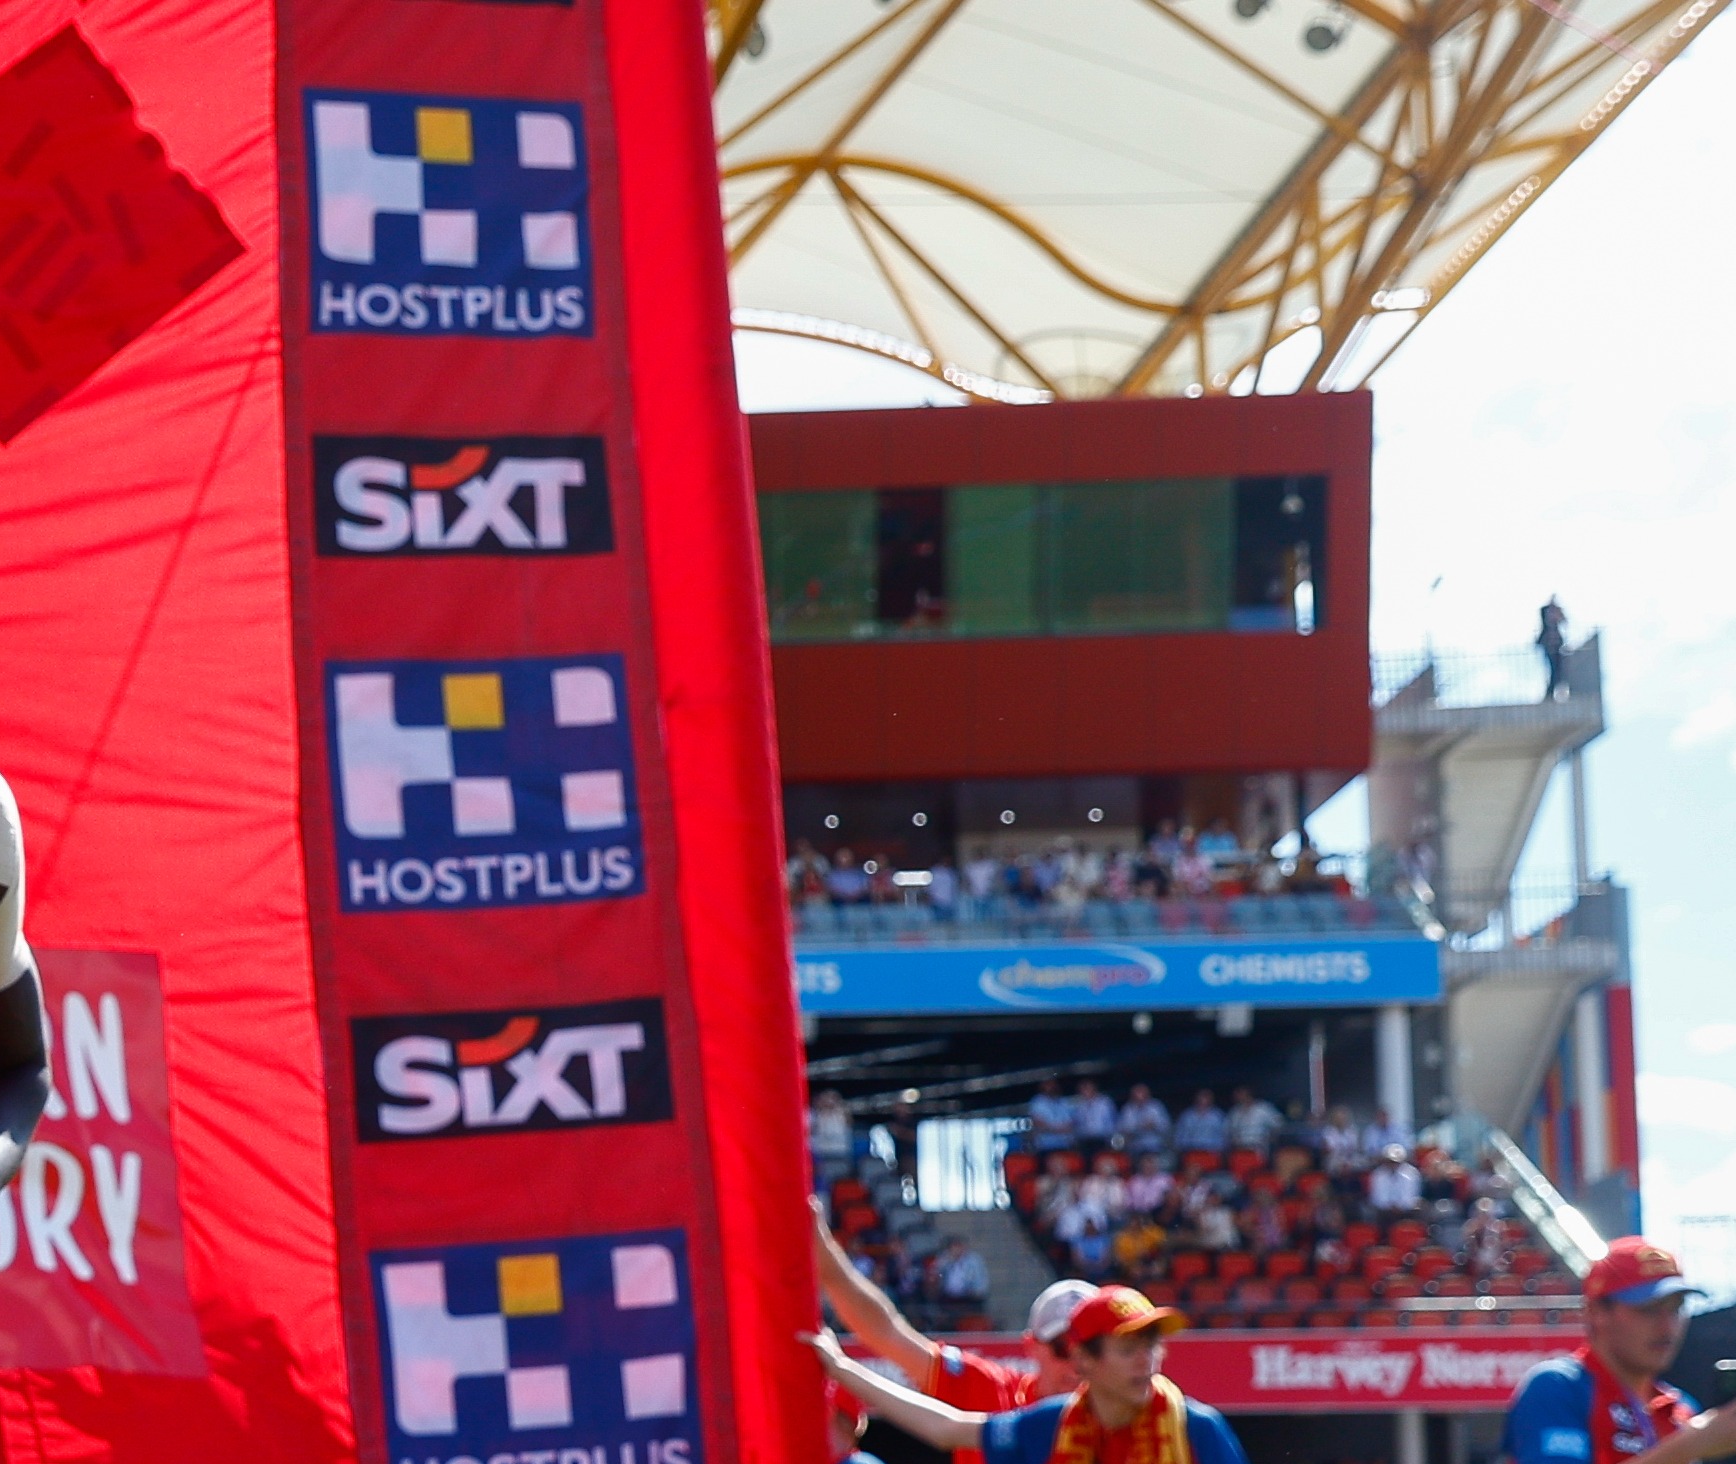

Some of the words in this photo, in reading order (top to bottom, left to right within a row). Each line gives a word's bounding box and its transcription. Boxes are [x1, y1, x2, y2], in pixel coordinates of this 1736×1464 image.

[319, 284, 585, 332] HOSTPLUS
[347, 847, 636, 903] HOSTPLUS
[1251, 1344, 1414, 1398] Harvey
